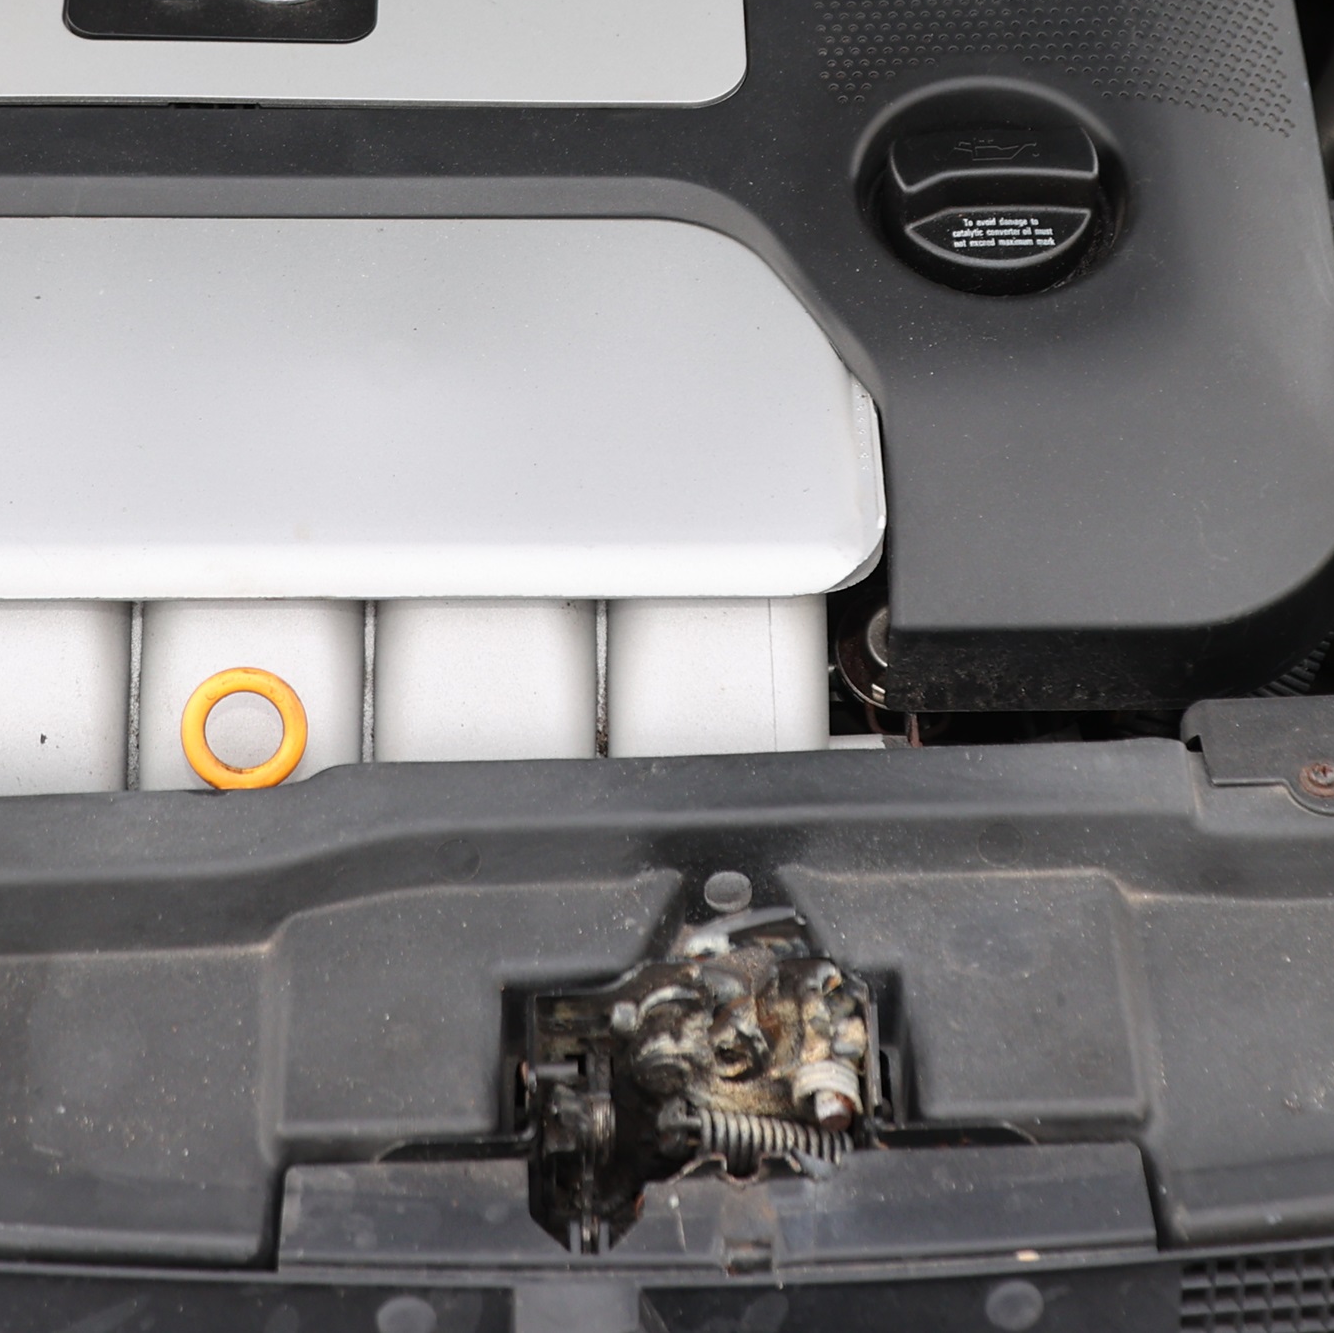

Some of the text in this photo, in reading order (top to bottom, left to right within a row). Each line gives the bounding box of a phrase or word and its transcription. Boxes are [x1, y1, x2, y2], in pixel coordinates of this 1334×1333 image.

[963, 217, 1039, 227] To avoid damage to
[952, 228, 984, 238] catalytic
[986, 228, 1020, 236] converter
